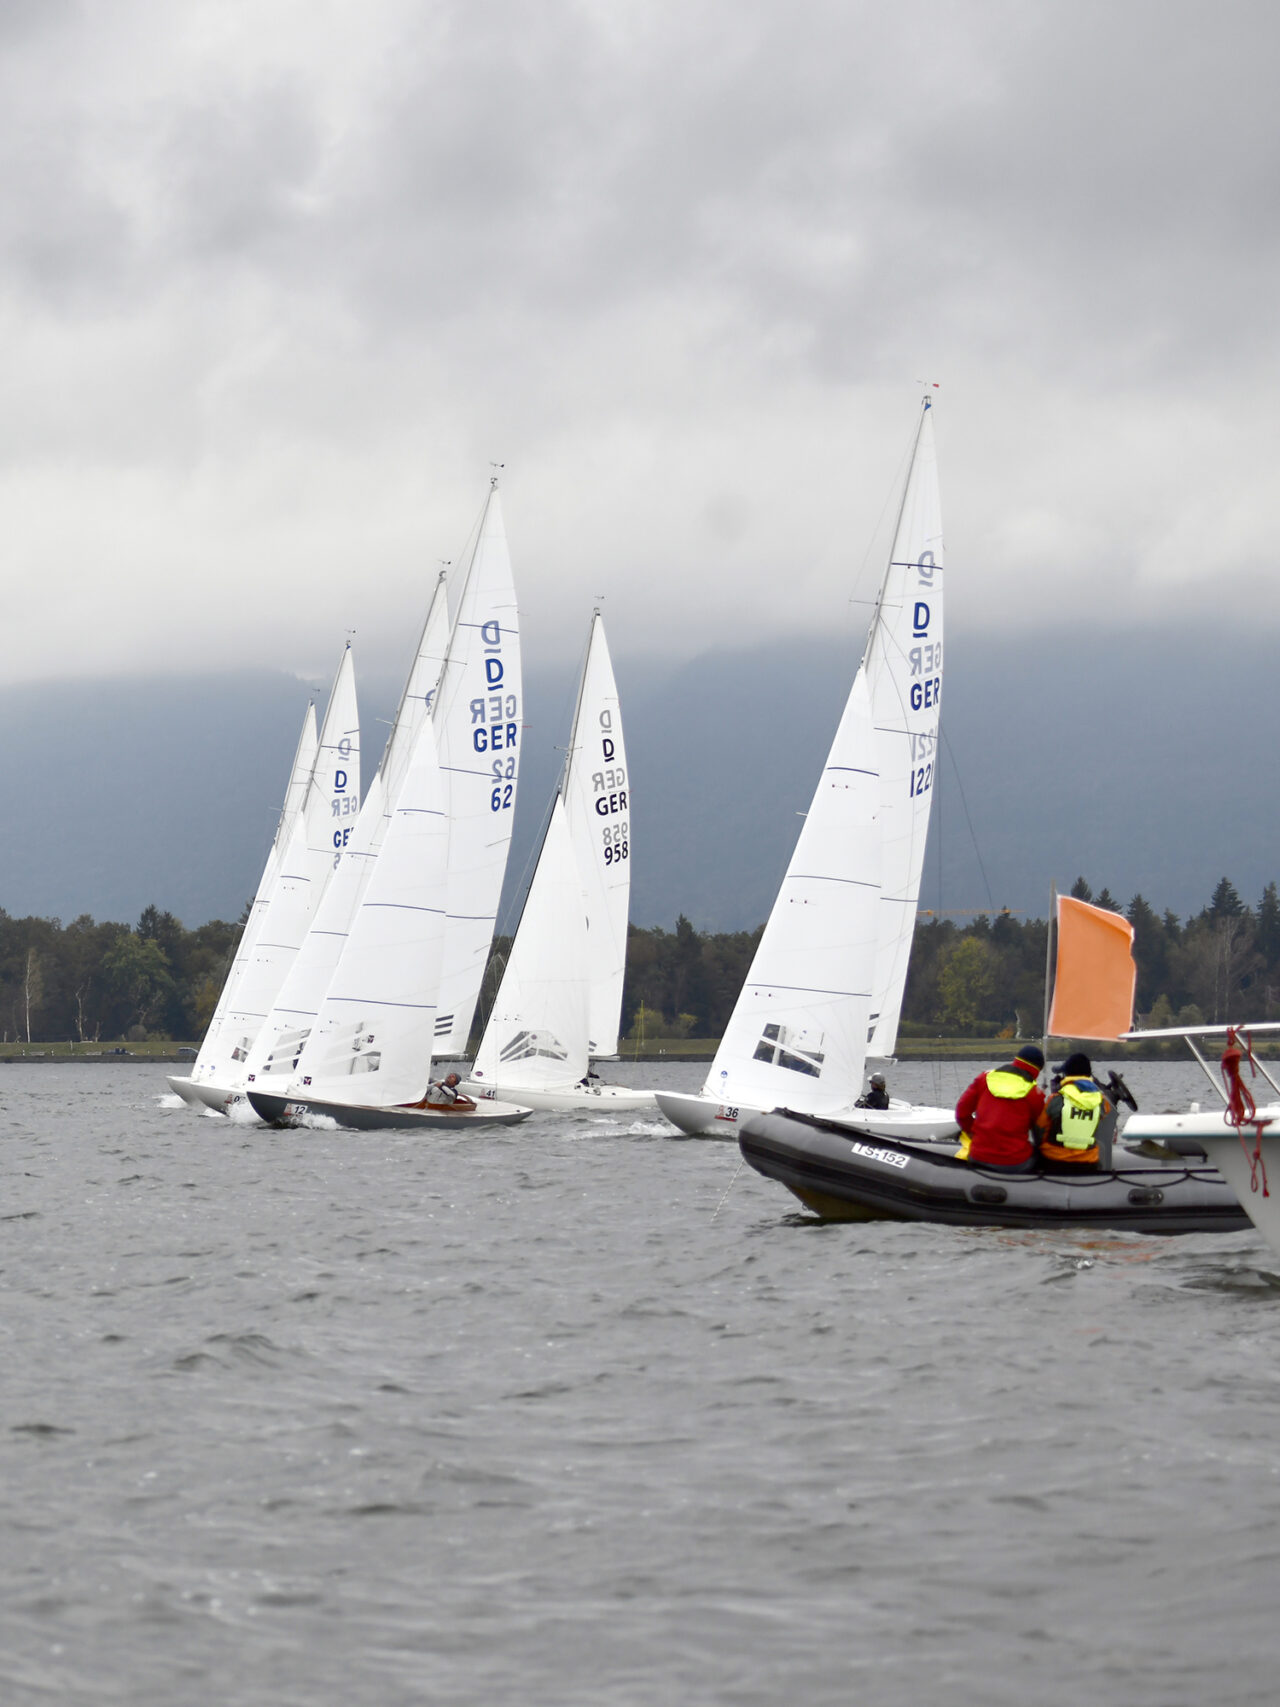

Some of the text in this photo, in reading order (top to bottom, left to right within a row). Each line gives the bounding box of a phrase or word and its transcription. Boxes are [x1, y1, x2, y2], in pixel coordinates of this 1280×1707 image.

[913, 602, 930, 638] D
[485, 658, 504, 691] D
[910, 677, 940, 711] GER
[473, 722, 517, 752] GER
[602, 739, 615, 762] D
[334, 770, 347, 793] D
[491, 784, 513, 812] 62
[595, 791, 628, 816] GER
[333, 827, 354, 848] GE
[604, 841, 629, 865] 958
[294, 1105, 306, 1115] 12
[725, 1107, 739, 1118] 36
[1070, 1107, 1093, 1121] HH
